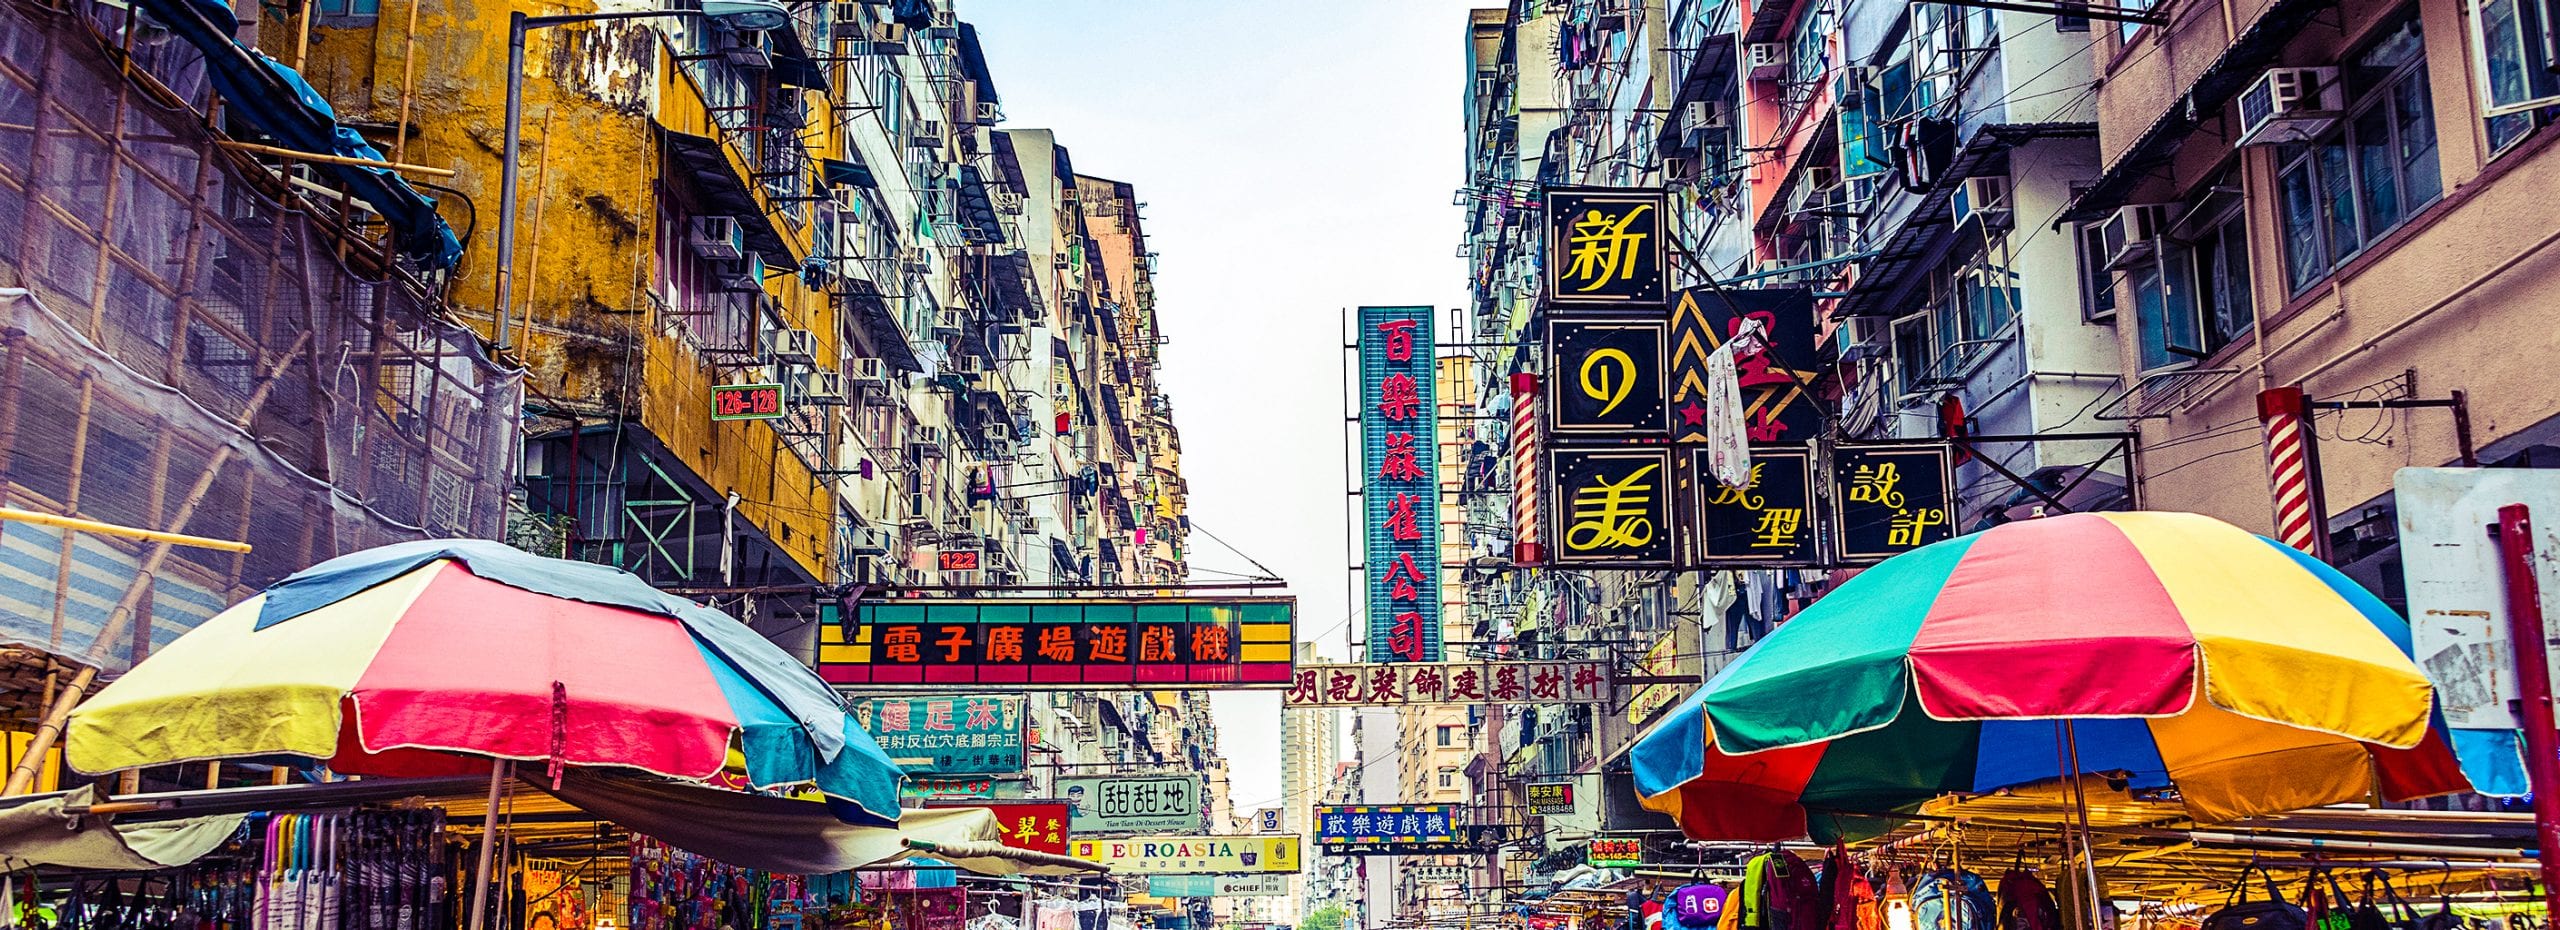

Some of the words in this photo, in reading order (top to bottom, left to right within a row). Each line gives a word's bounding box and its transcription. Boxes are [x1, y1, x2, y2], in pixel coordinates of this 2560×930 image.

[716, 389, 777, 414] 126-128
[940, 552, 977, 569] 122
[883, 625, 1229, 662] 電子廣場遊戲機
[1105, 783, 1185, 814] 甜甜地
[1166, 818, 1186, 826] House
[1263, 810, 1279, 829] 昌
[1326, 814, 1446, 836] 歡樂遊戲機
[1112, 843, 1233, 858] EUROASIA
[1232, 884, 1260, 892] CHIEF
